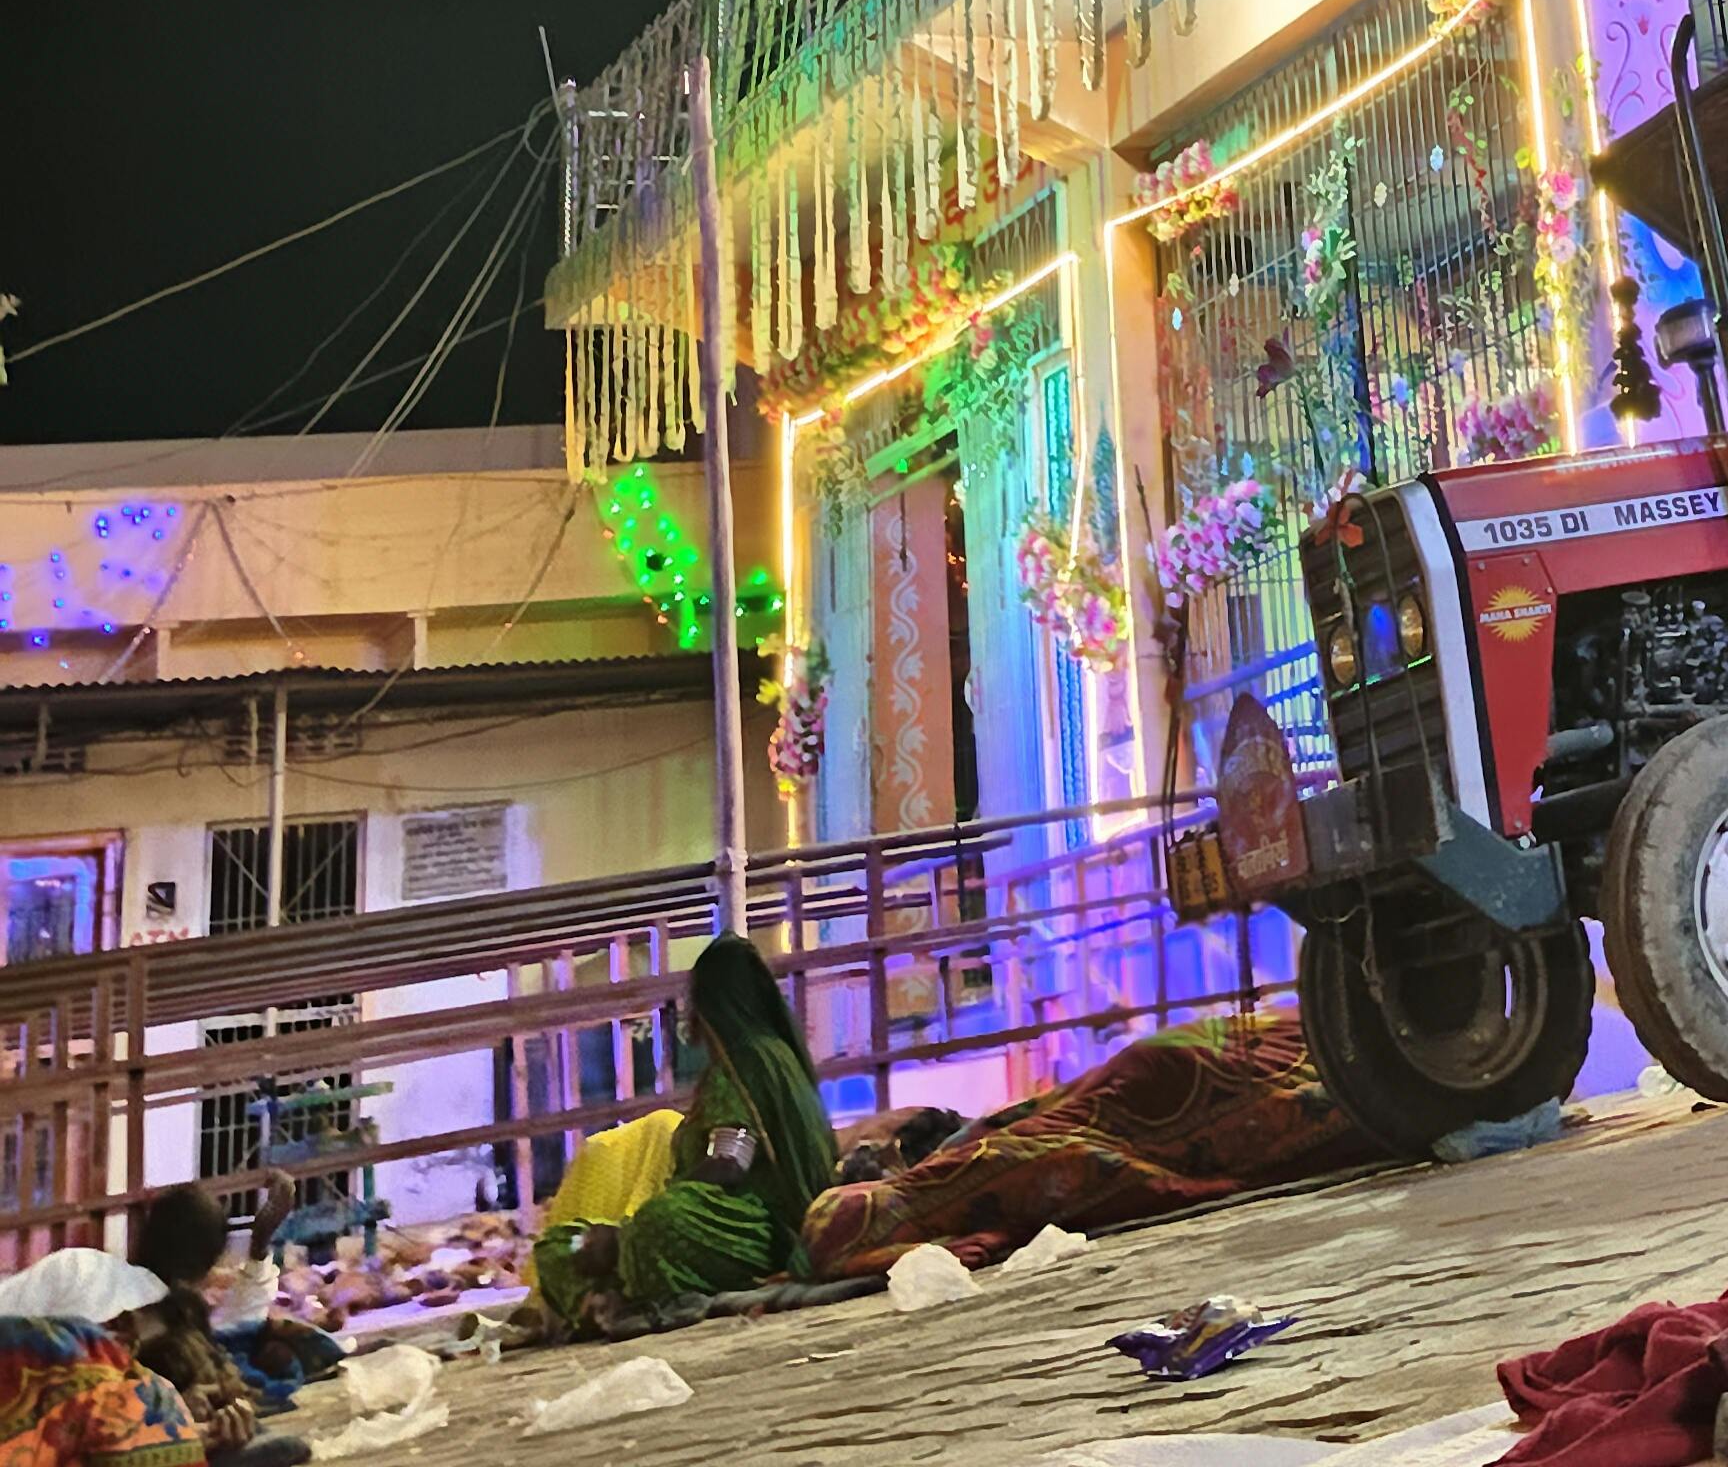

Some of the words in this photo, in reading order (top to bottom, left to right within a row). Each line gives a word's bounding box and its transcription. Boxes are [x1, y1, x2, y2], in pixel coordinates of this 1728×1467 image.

[1483, 516, 1553, 545] 1035
[1560, 511, 1589, 536] DI
[1614, 493, 1720, 527] MASSEY
